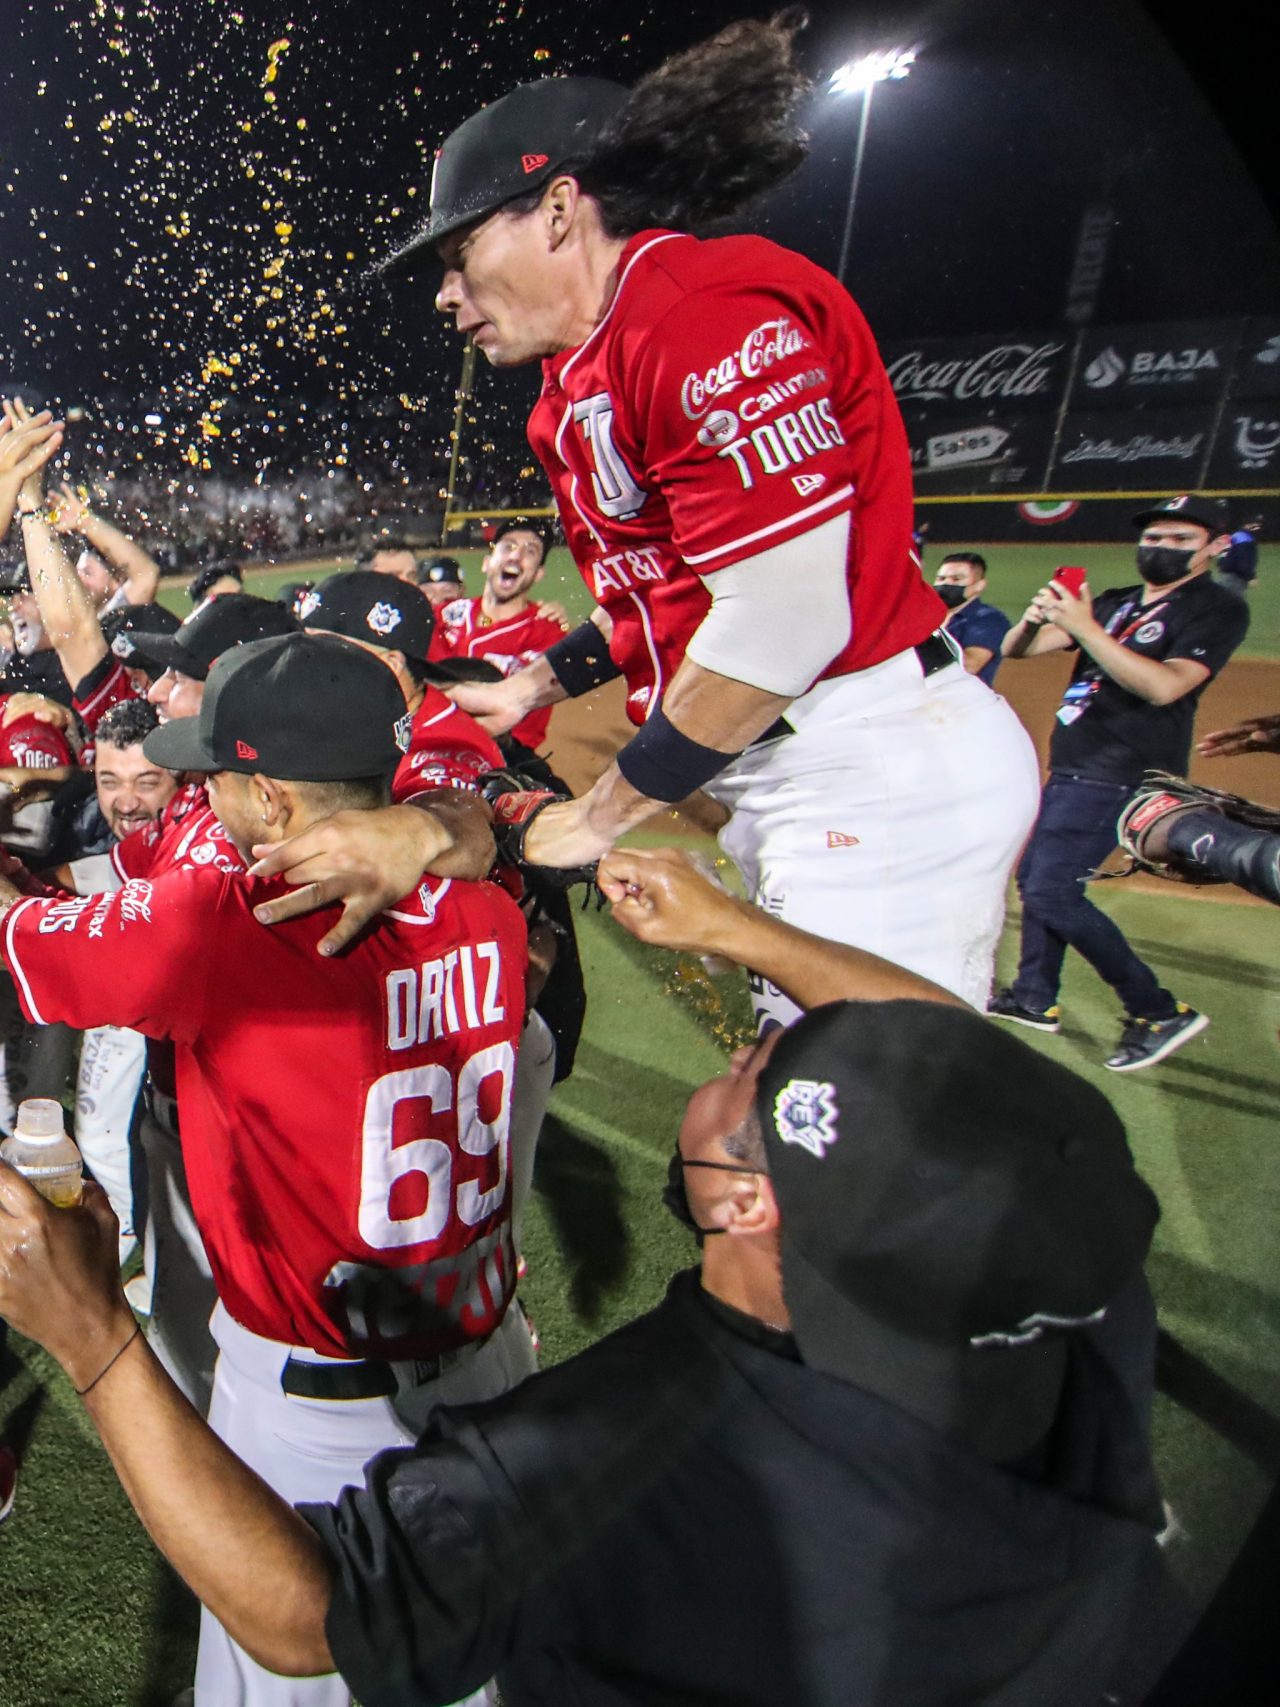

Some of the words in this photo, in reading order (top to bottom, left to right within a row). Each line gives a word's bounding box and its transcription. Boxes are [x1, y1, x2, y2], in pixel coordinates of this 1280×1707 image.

[682, 317, 804, 420] Coca-Cola
[885, 342, 1065, 400] Coca-Cola
[1131, 349, 1218, 374] BAJA
[718, 398, 846, 490] TOROS
[933, 434, 991, 458] Saes
[593, 548, 664, 598] AT&T
[386, 941, 504, 1051] ORTIZ
[80, 1032, 105, 1086] BAJA
[358, 1041, 516, 1250] 69
